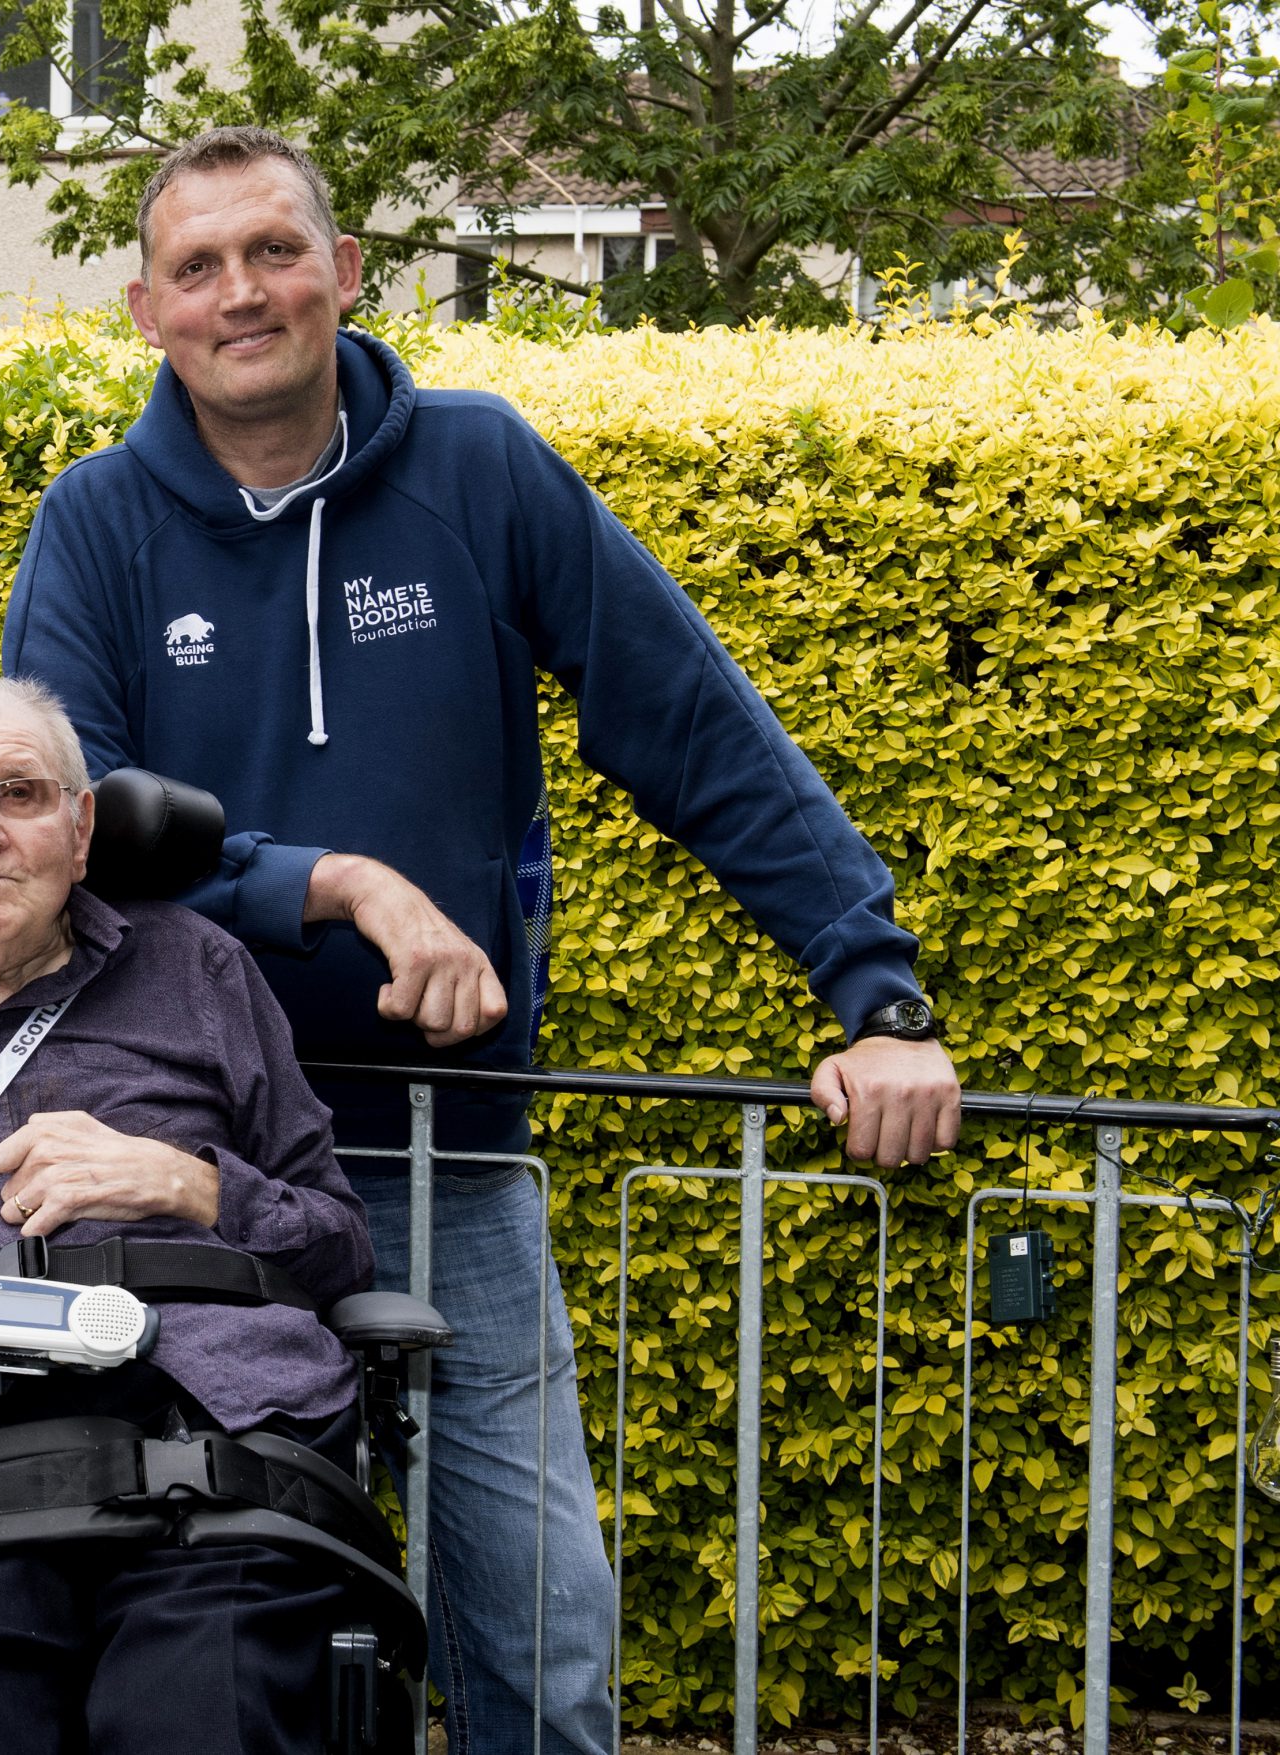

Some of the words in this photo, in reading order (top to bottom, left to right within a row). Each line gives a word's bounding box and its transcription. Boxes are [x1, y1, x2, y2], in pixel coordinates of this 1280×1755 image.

[343, 576, 373, 597] MY
[348, 598, 435, 631] DODDIE
[351, 618, 437, 645] foundation
[167, 643, 215, 656] RAGING
[175, 655, 209, 666] BULL
